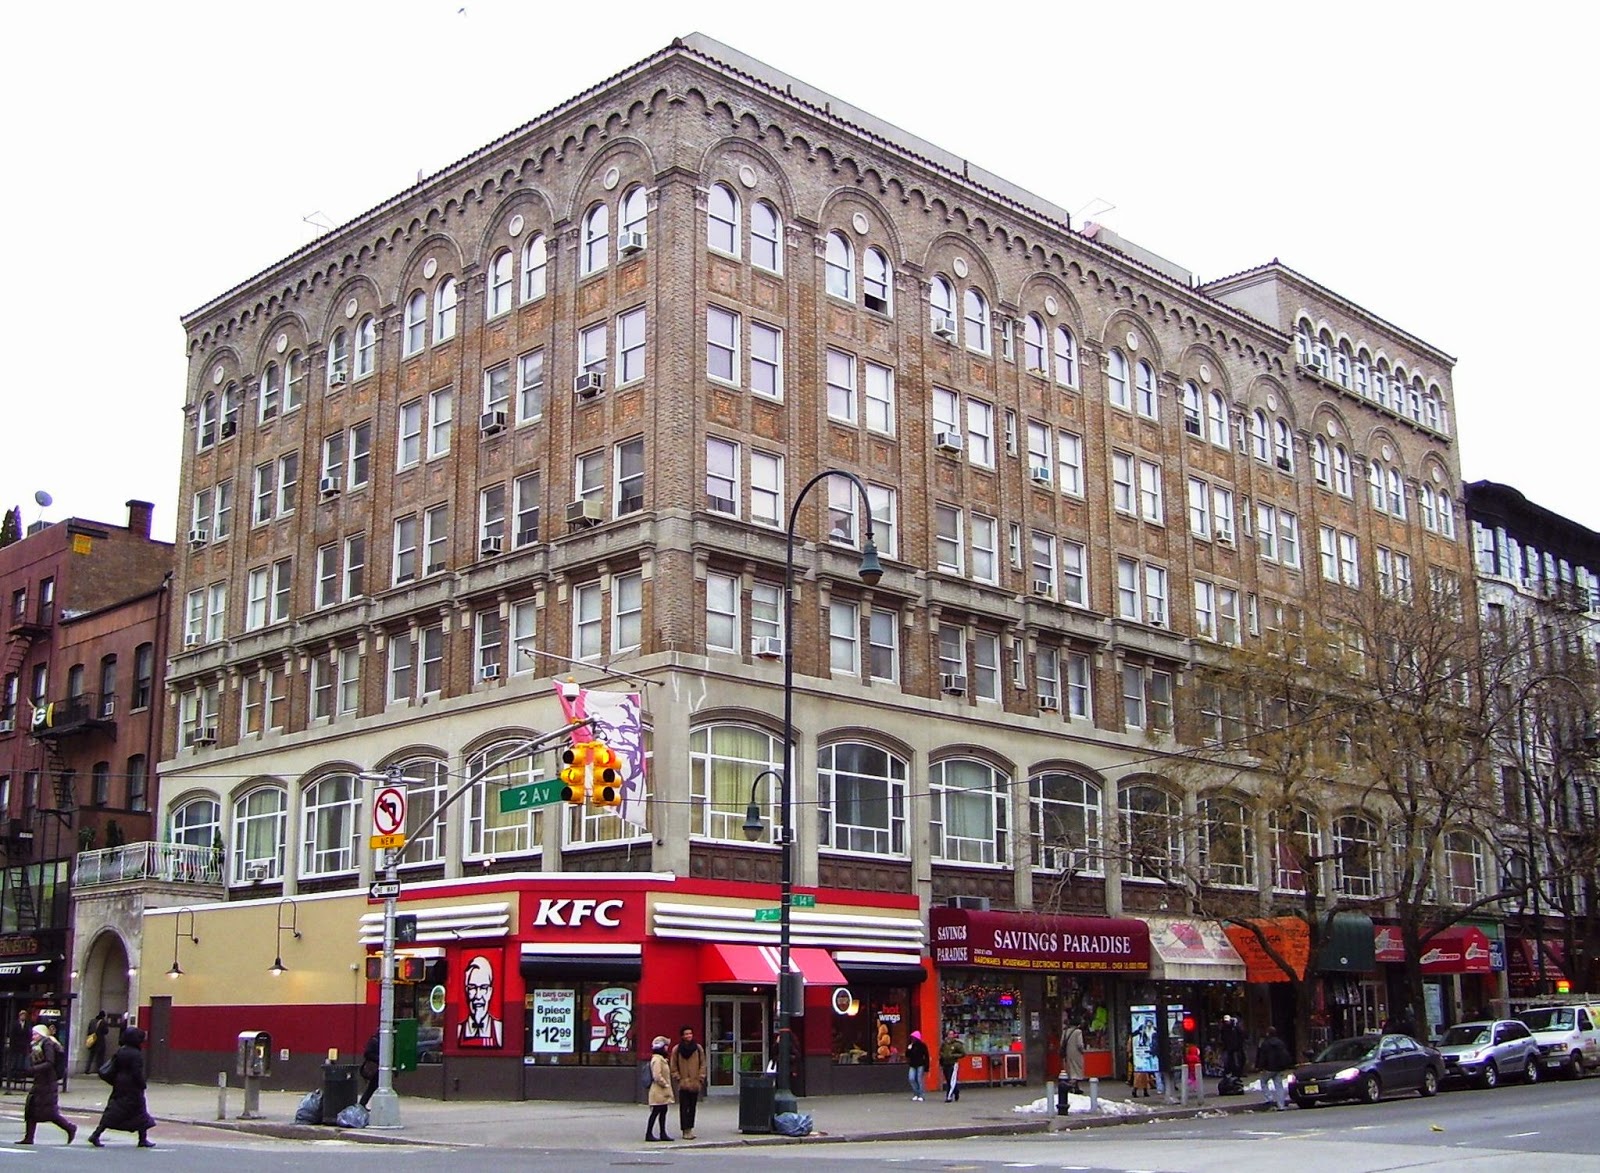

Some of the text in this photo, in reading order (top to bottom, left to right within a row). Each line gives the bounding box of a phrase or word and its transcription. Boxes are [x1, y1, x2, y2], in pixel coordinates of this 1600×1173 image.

[519, 791, 527, 805] 2
[380, 837, 395, 846] NEW
[374, 886, 383, 894] ONE
[533, 899, 624, 927] KFC
[761, 910, 767, 920] 2
[1063, 934, 1131, 954] PARADISE
[937, 947, 968, 962] PARADISE
[1032, 960, 1061, 968] ELECTRONICS
[1061, 961, 1074, 969] GIFTS
[596, 997, 619, 1006] KFC
[537, 1005, 571, 1018] 8 piece
[882, 1004, 899, 1014] hot
[542, 1015, 566, 1024] meal
[878, 1014, 901, 1024] wings
